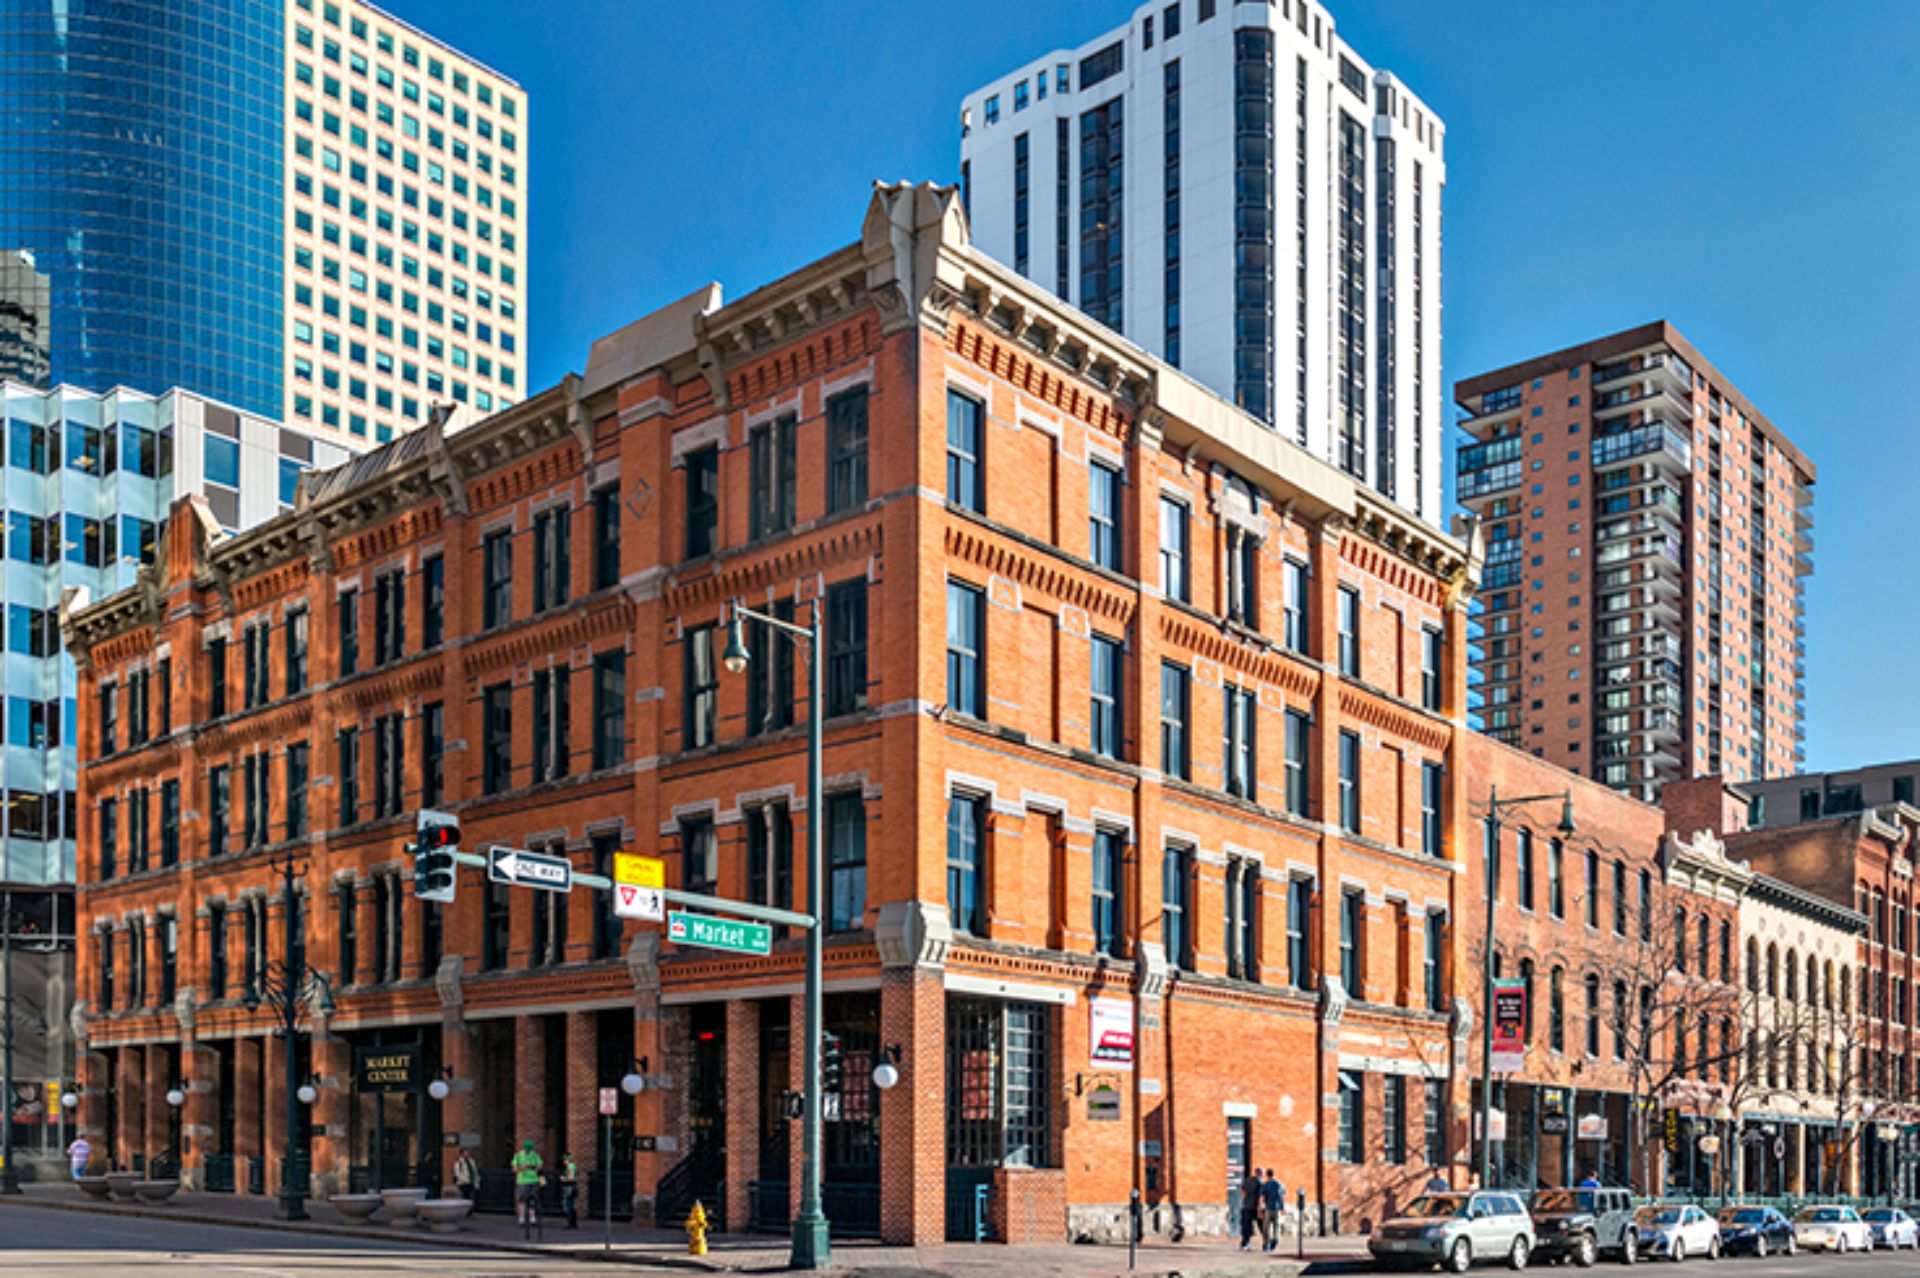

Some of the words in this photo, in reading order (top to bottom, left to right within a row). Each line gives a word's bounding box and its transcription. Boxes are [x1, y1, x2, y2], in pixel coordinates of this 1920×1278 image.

[540, 866, 562, 879] WAY
[693, 921, 744, 947] Market
[365, 1056, 410, 1069] MARKET
[367, 1070, 409, 1083] CENTER
